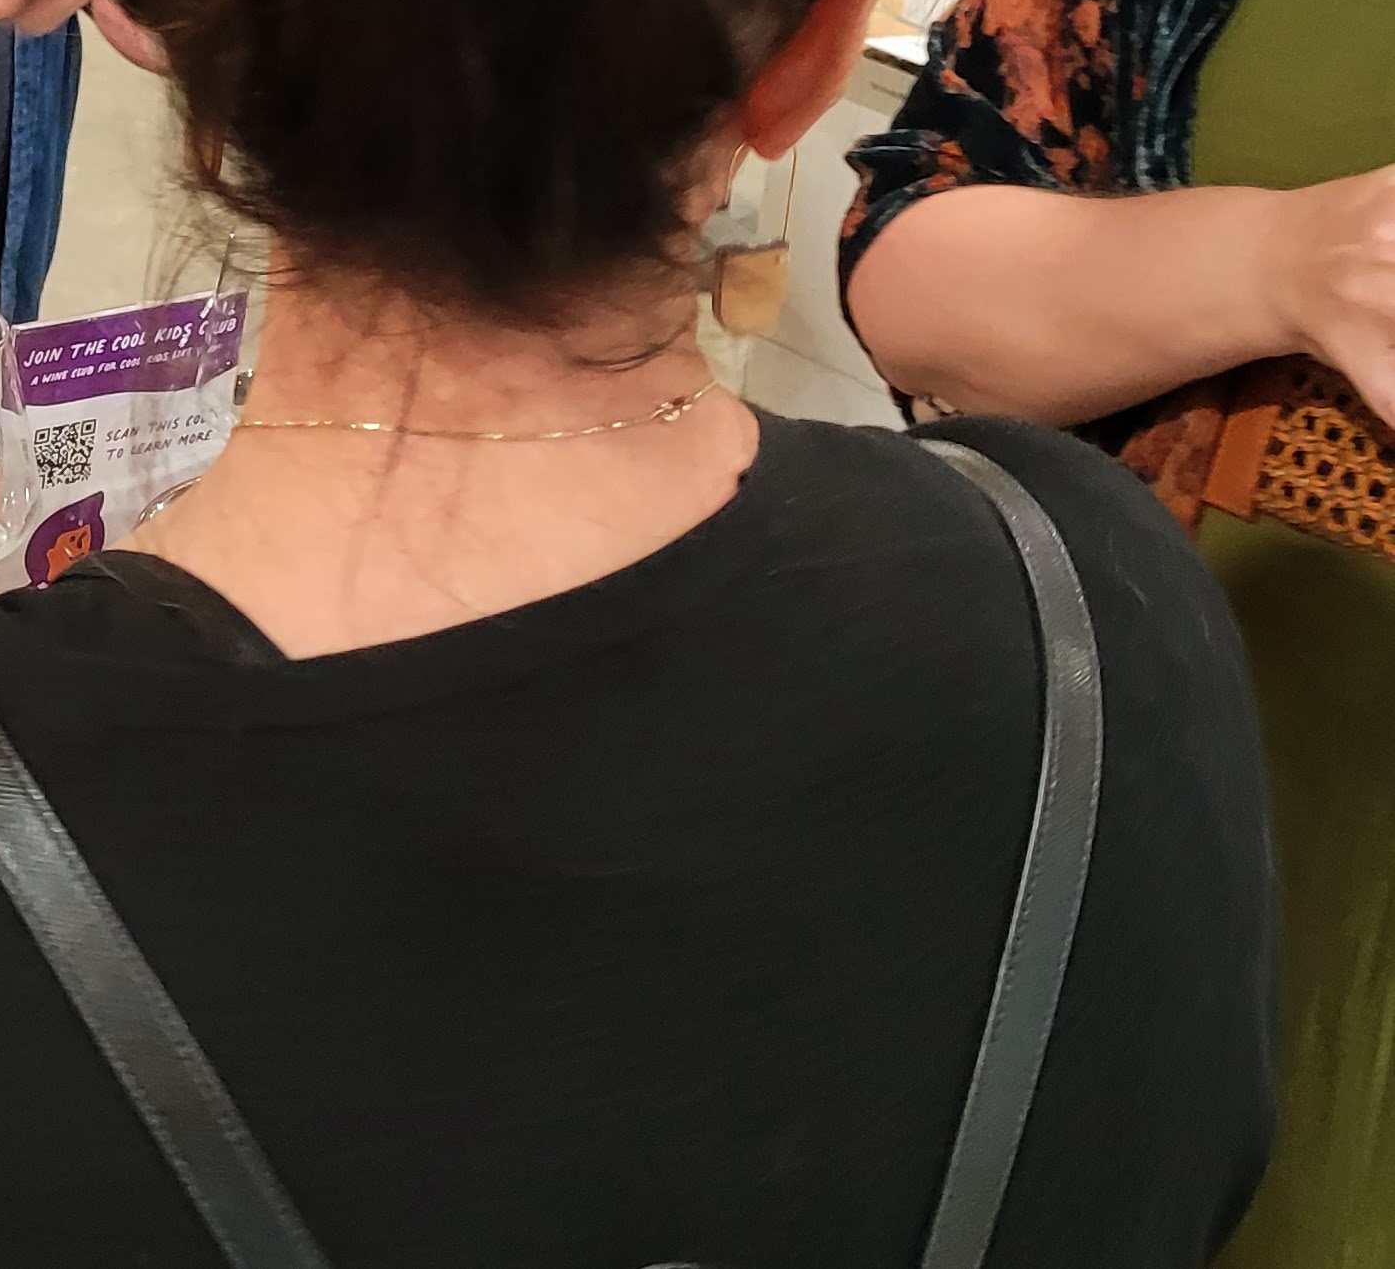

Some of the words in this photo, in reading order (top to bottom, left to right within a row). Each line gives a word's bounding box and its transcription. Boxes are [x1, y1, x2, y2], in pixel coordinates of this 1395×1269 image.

[24, 346, 64, 367] JOIN
[70, 339, 105, 359] THE
[111, 330, 146, 352] COOL
[154, 322, 193, 343] KIDS
[30, 374, 39, 386] A
[42, 369, 68, 384] WINE
[71, 365, 95, 379] CLUB
[98, 360, 117, 373] FOR
[120, 356, 141, 370] COOL
[145, 352, 169, 365] KIDS
[105, 426, 139, 443] SCAN
[147, 417, 180, 432] THIS
[106, 448, 124, 461] TO
[130, 439, 172, 455] LEARN
[177, 429, 213, 445] MORE
